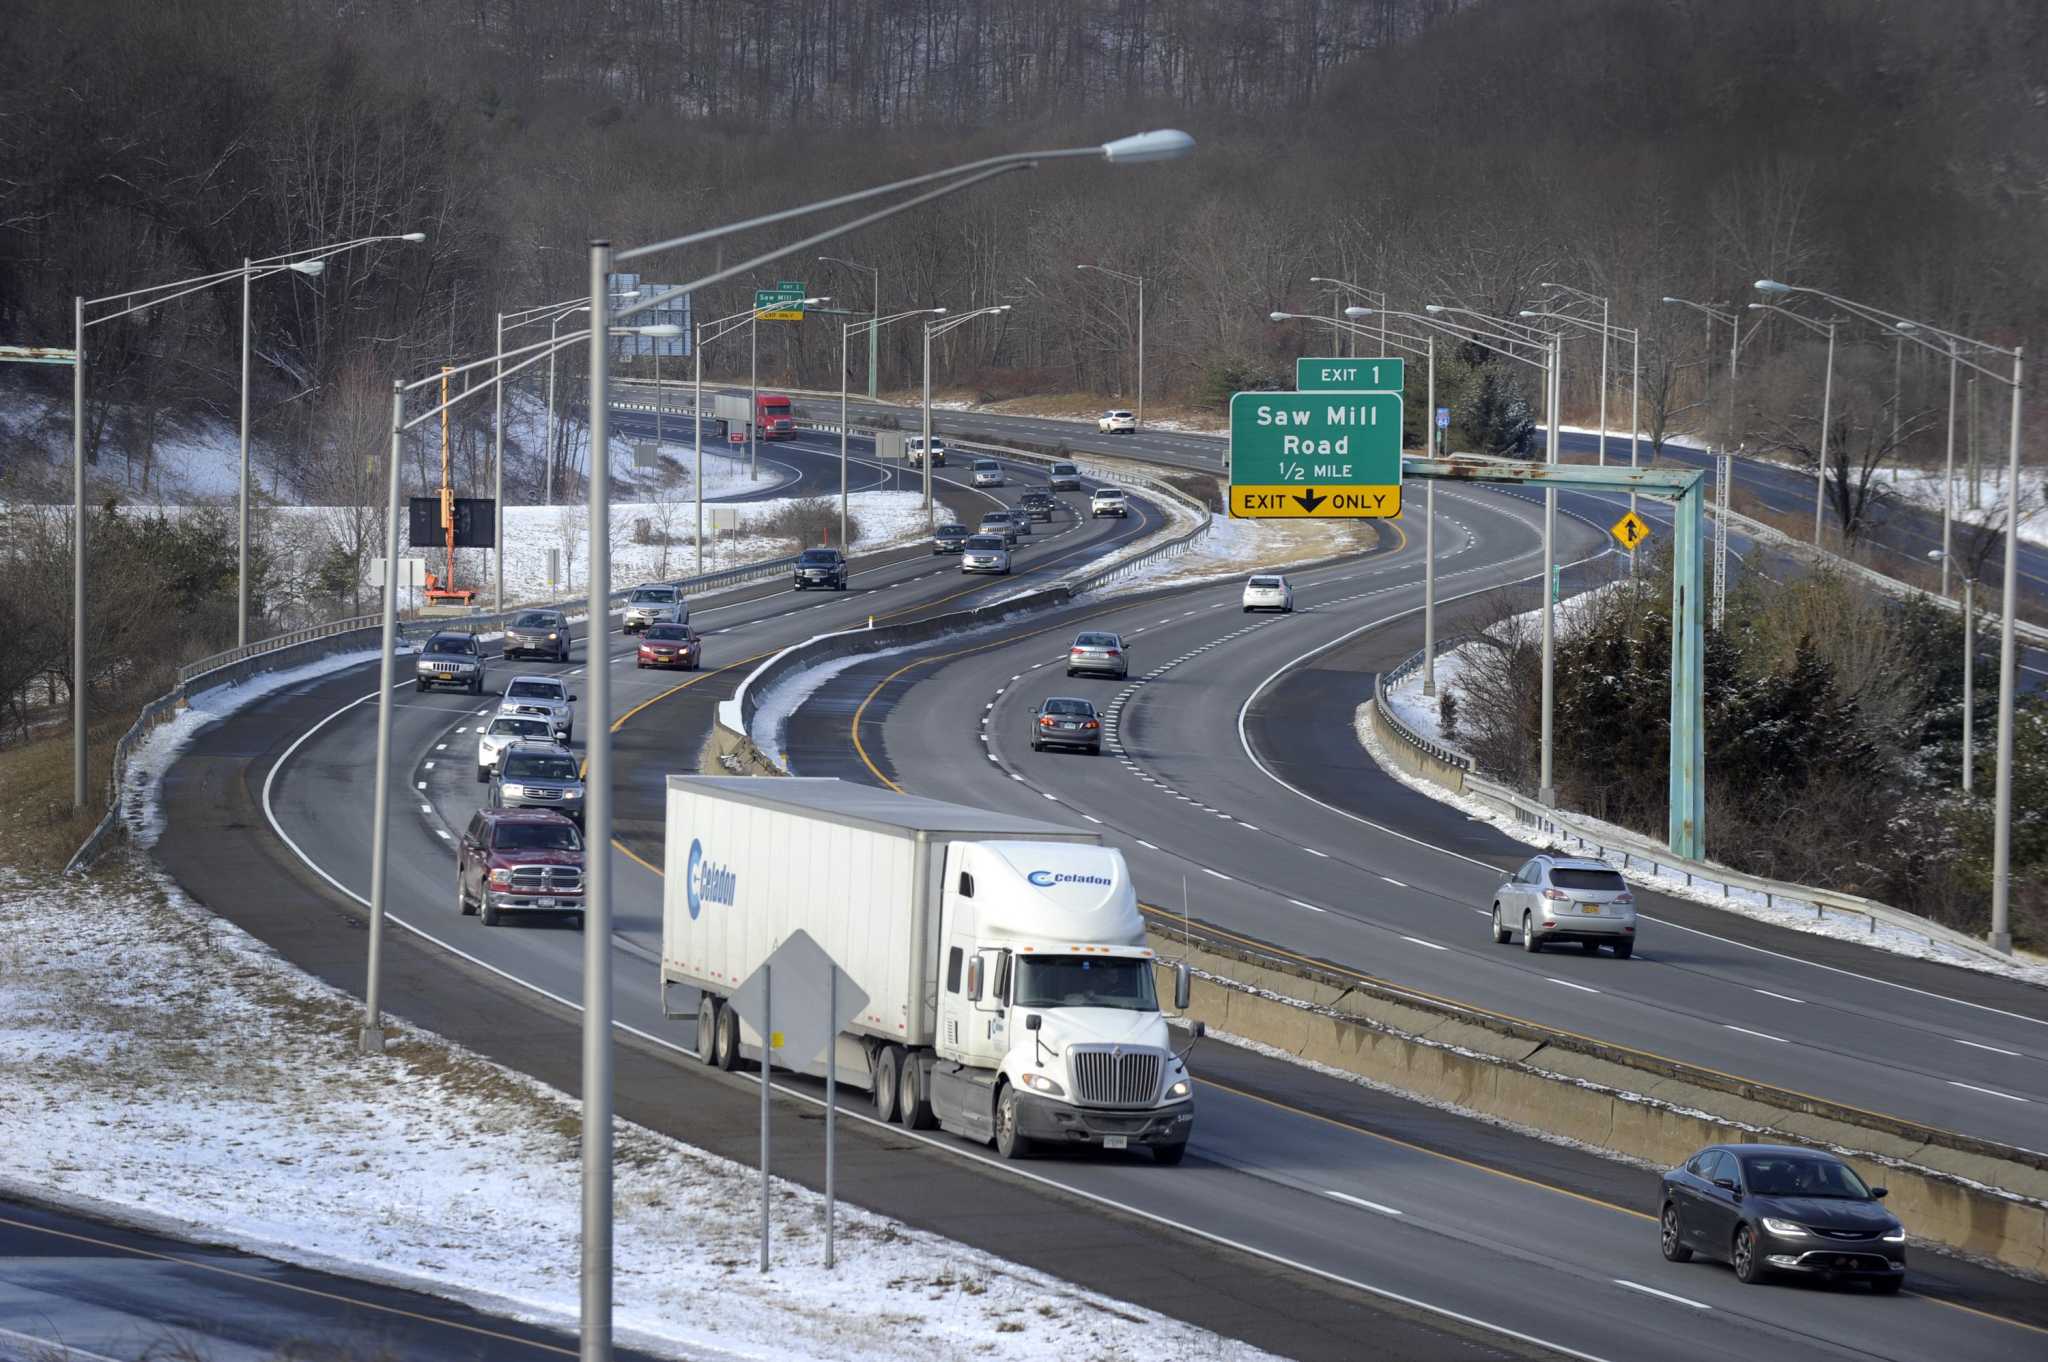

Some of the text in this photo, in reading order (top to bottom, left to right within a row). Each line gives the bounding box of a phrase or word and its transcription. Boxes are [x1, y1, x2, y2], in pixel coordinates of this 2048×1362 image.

[1321, 366, 1380, 384] EXIT 1
[1256, 405, 1377, 426] Saw Mill
[1283, 435, 1349, 455] Road
[1314, 464, 1353, 478] MILE
[1244, 494, 1386, 509] EXIT ONLY
[700, 860, 737, 907] Celadon
[1054, 873, 1112, 886] Celadon
